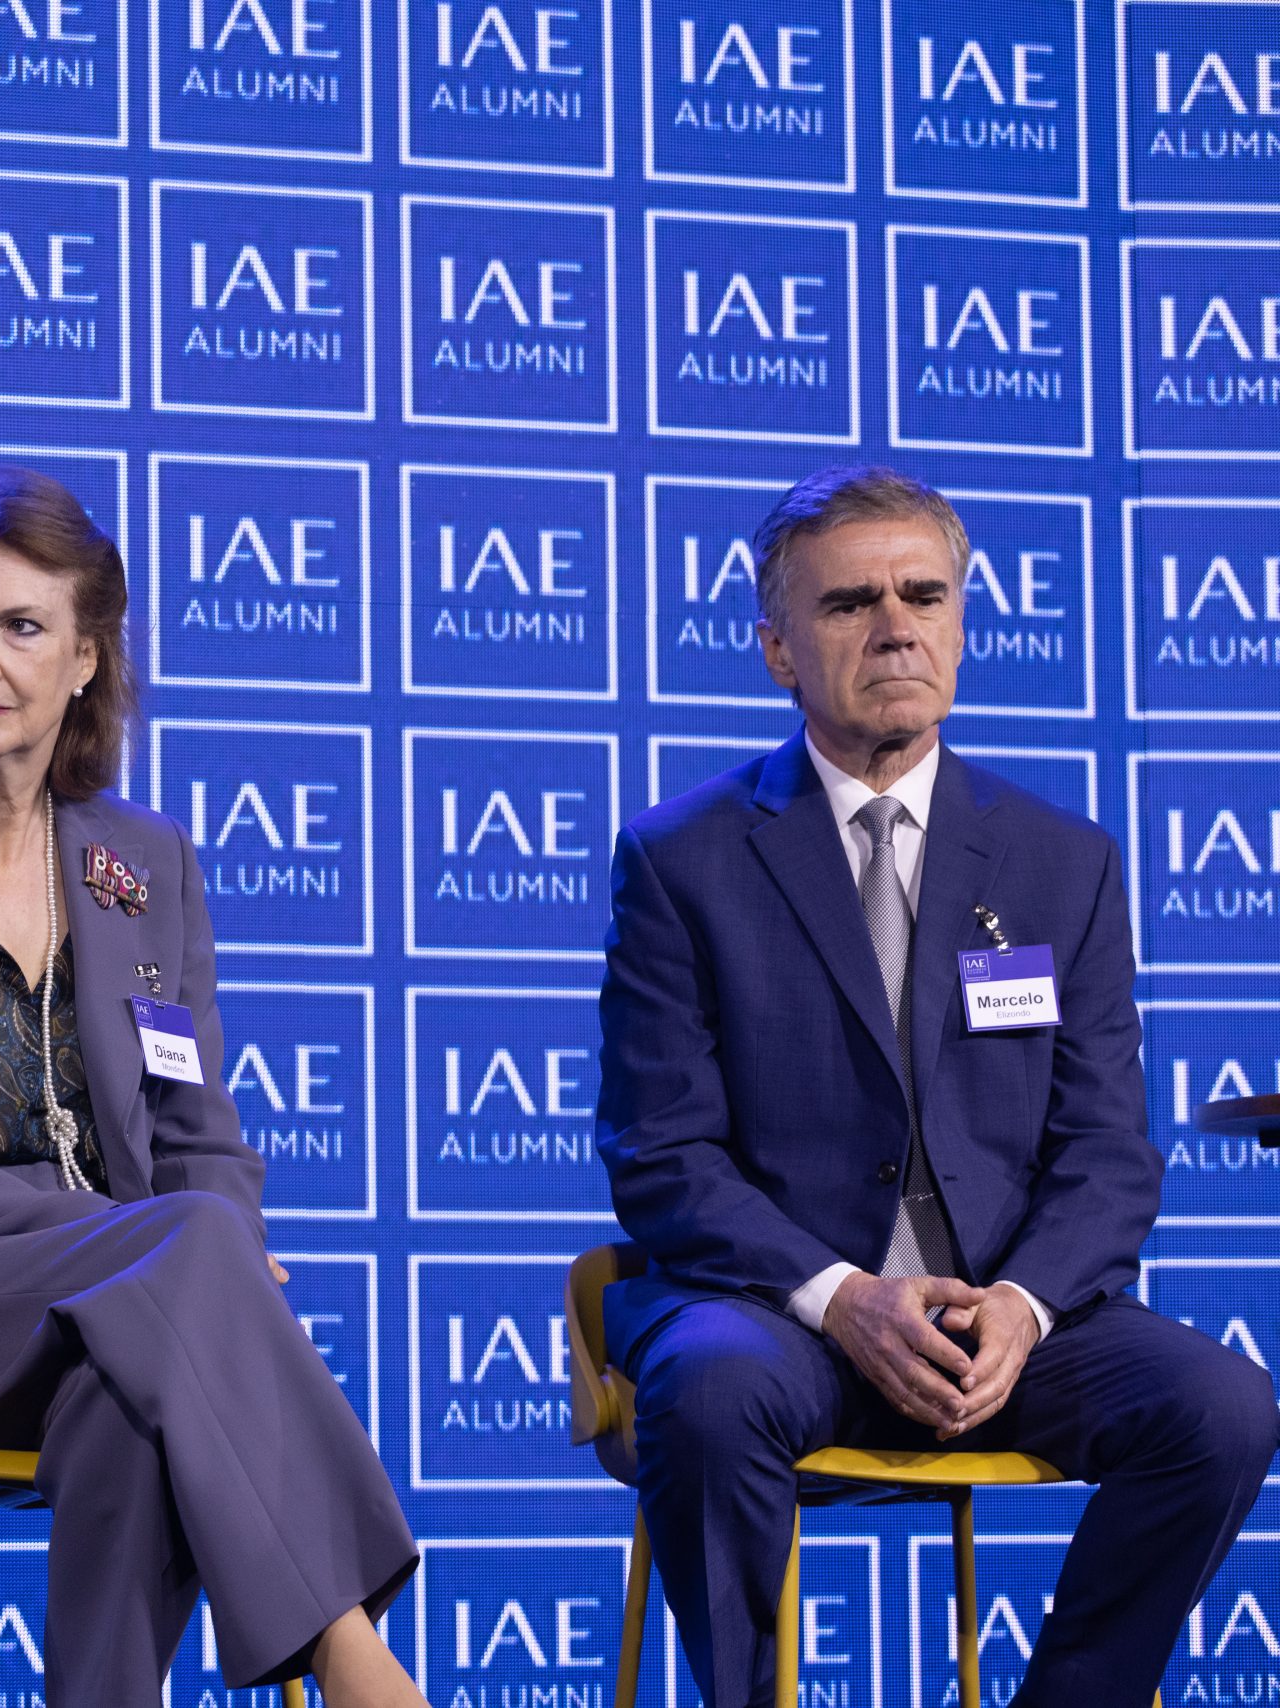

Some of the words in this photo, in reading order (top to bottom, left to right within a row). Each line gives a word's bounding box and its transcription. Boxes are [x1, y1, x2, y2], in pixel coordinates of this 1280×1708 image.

[190, 0, 338, 58] IAE
[438, 3, 581, 74] IAE
[681, 20, 822, 91] IAE
[920, 38, 1055, 107] IAE
[183, 67, 338, 102] ALUMNI
[431, 83, 581, 118] ALUMNI
[675, 100, 822, 134] ALUMNI
[914, 116, 1056, 150] ALUMNI
[1150, 130, 1280, 157] ALUMN
[192, 243, 340, 315] IAE
[441, 257, 584, 328] IAE
[685, 271, 826, 341] IAE
[924, 286, 1060, 354] IAE
[184, 326, 341, 360] ALUMNI
[434, 339, 584, 373] ALUMNI
[678, 352, 827, 385] ALUMNI
[918, 365, 1061, 398] ALUMNI
[1155, 376, 1280, 404] ALUM
[190, 515, 338, 586] IAE
[441, 526, 585, 596] IAE
[685, 537, 755, 601] IA
[965, 550, 1063, 616] AE
[1163, 556, 1280, 620] IA
[183, 599, 337, 632] ALUMNI
[434, 609, 584, 641] ALUMNI
[678, 619, 754, 650] ALU
[969, 631, 1063, 660] UMNI
[1158, 636, 1280, 665] ALUM
[192, 781, 339, 850] IAE
[443, 789, 587, 857] IAE
[1169, 810, 1280, 872] IA
[203, 866, 339, 895] LUMNI
[436, 871, 587, 901] ALUMNI
[1163, 889, 1273, 917] ALUM
[966, 958, 986, 968] IAE
[977, 992, 1044, 1008] Marcelo
[154, 1044, 187, 1064] Diana
[228, 1045, 342, 1112] AE
[446, 1048, 591, 1115] IAE
[1173, 1060, 1280, 1123] IA
[440, 1132, 591, 1162] ALUMNI
[1168, 1141, 1280, 1169] ALUM
[456, 1600, 602, 1667] IAE
[948, 1594, 1054, 1662] IA
[1189, 1592, 1280, 1656] IA
[1183, 1674, 1280, 1703] ALU
